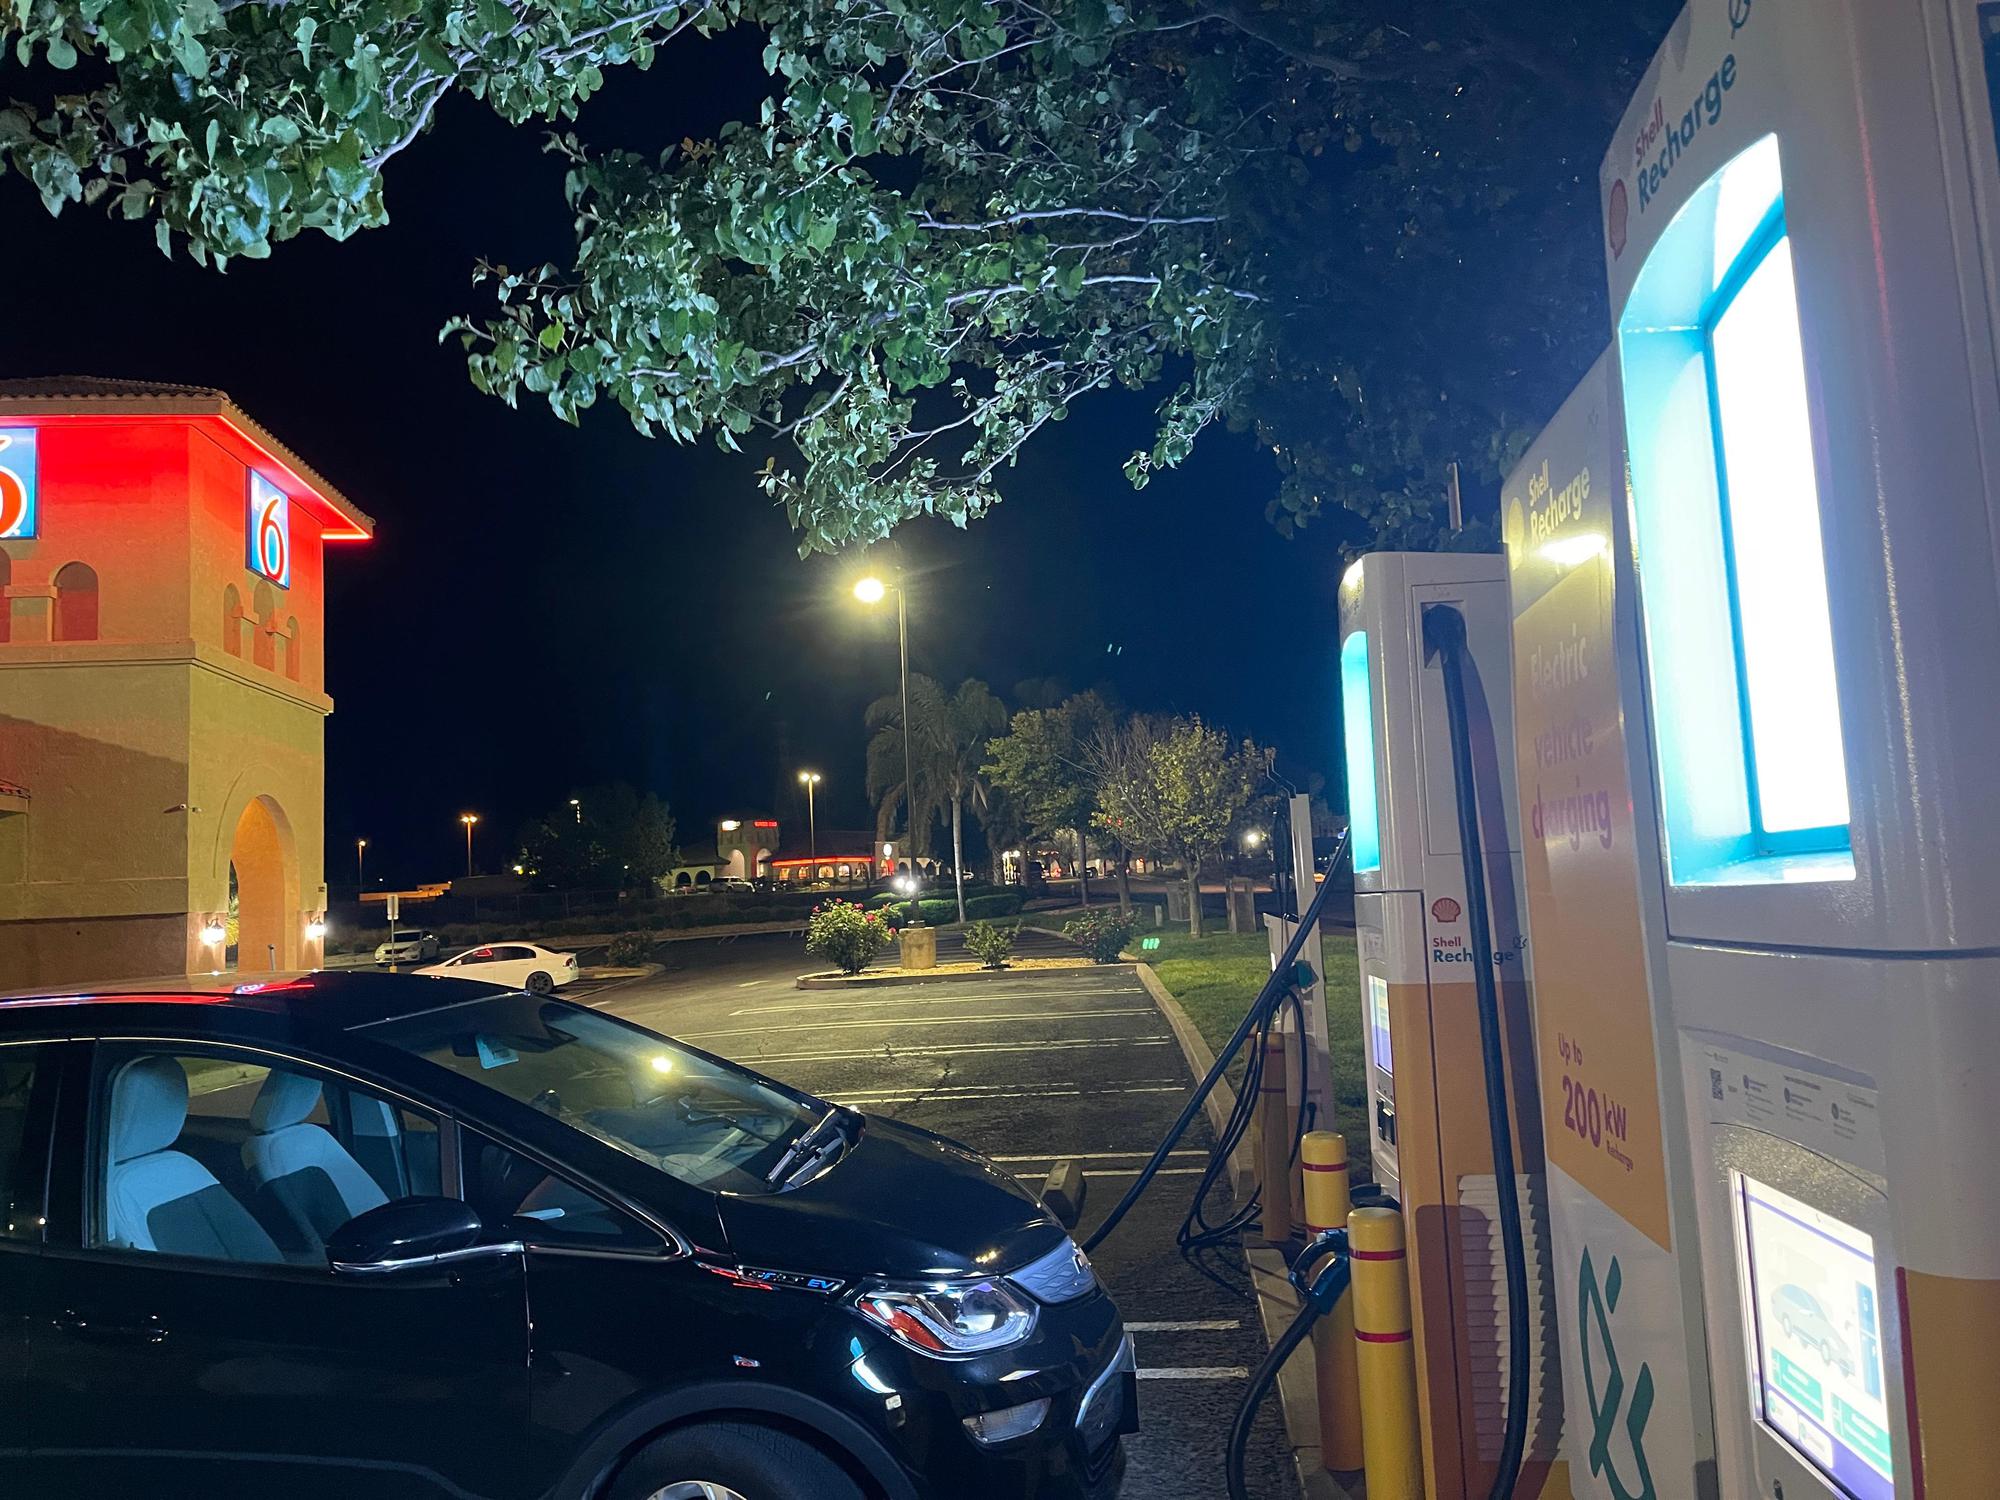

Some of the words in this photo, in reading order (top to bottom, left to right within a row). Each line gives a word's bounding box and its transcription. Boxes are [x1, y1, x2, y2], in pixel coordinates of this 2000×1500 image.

[1635, 96, 1663, 168] Shell
[1638, 53, 1737, 214] Recharge
[1529, 459, 1549, 507] Shell
[1531, 467, 1590, 544] Recharge
[257, 495, 285, 581] 6
[1531, 622, 1588, 698] Electric
[1534, 714, 1593, 768] vehicle
[1531, 775, 1612, 851] charging
[1433, 936, 1462, 947] Shell
[1433, 947, 1514, 965] Rechge
[1558, 1032, 1571, 1066] Up
[1573, 1038, 1583, 1066] to
[1562, 1075, 1601, 1148] 200
[1603, 1093, 1626, 1142] kW
[807, 1279, 835, 1289] EV
